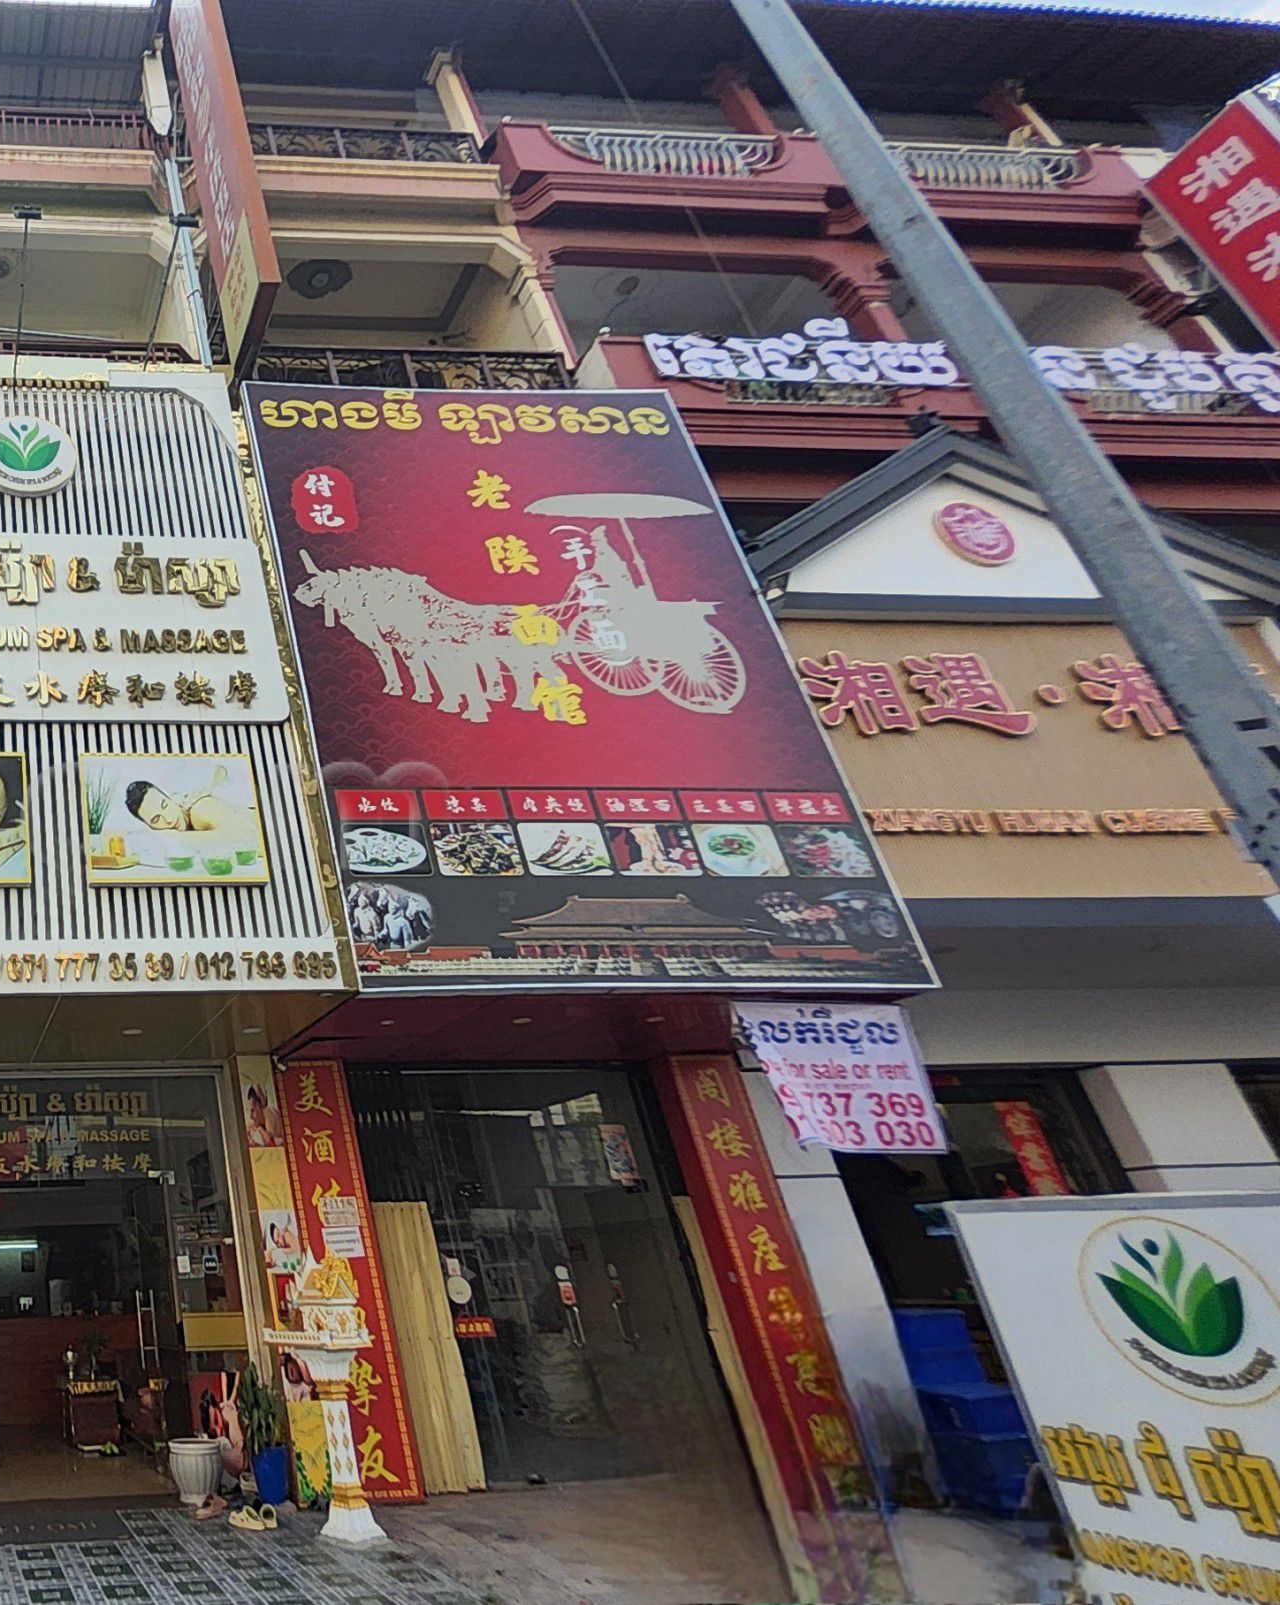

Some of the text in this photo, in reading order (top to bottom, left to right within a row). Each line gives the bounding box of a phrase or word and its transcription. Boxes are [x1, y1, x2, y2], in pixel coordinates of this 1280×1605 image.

[260, 390, 422, 429] ហាងមី
[304, 473, 346, 530] 付记
[66, 556, 101, 593] &
[467, 469, 588, 725] 老陕面馆
[35, 626, 88, 652] SPA
[93, 627, 113, 652] &
[120, 628, 249, 653] MASSAGE
[54, 952, 100, 983] 777
[195, 951, 236, 981] 012
[811, 1057, 849, 1081] sale
[852, 1062, 873, 1081] or
[876, 1060, 914, 1081] rent
[865, 1092, 927, 1118] 369
[75, 1129, 151, 1143] MASSAGE
[875, 1119, 937, 1147] 030
